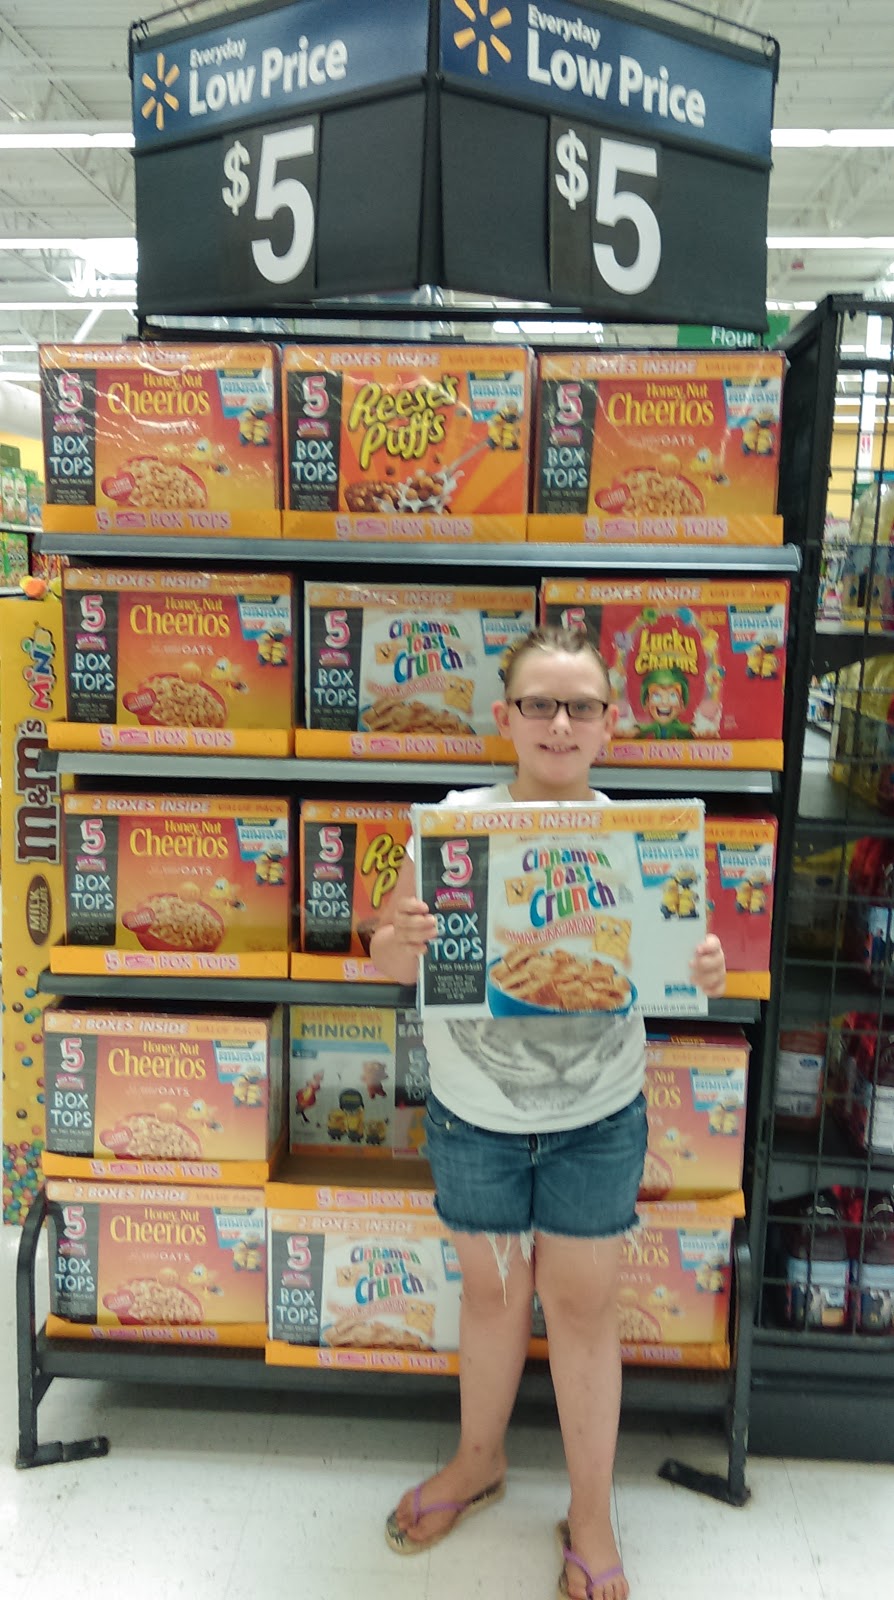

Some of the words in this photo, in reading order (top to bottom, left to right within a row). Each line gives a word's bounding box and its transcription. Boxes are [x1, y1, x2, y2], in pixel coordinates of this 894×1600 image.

[528, 3, 600, 50] Everyday
[190, 38, 247, 69] Everyday
[189, 65, 256, 117] Low
[261, 35, 347, 99] Price
[527, 28, 612, 100] Low
[619, 54, 706, 128] Price
[330, 352, 382, 365] BOXES
[386, 352, 440, 367] INSIDE
[571, 360, 581, 373] 2
[586, 359, 638, 375] BOXES
[643, 360, 697, 375] INSIDE
[143, 373, 180, 389] Honey
[182, 373, 203, 388] Nut
[646, 383, 684, 398] Honey
[686, 383, 708, 397] Nut
[58, 373, 83, 413] 5
[108, 382, 210, 415] Cheerios
[302, 375, 329, 418] 5
[557, 384, 583, 426] 5
[608, 392, 714, 427] Cheerios
[53, 435, 90, 455] BOX
[295, 440, 334, 460] BOX
[50, 456, 93, 476] TOPS
[547, 447, 585, 467] BOX
[292, 462, 338, 482] TOPS
[543, 468, 588, 488] TOPS
[150, 512, 184, 529] BOX
[187, 512, 232, 529] TOPS
[391, 519, 426, 536] BOX
[429, 519, 473, 536] TOPS
[642, 519, 677, 537] BOX
[683, 518, 728, 537] TOPS
[106, 574, 155, 588] BOXES
[161, 575, 210, 589] INSIDE
[590, 585, 642, 600] BOXES
[647, 586, 701, 599] INSIDE
[80, 594, 106, 633] 5
[165, 597, 200, 612] Honey
[202, 597, 223, 612] Nut
[130, 604, 230, 637] Cheerios
[325, 610, 350, 649] 5
[390, 618, 460, 639] Cinnamon
[182, 645, 214, 655] OATS
[407, 634, 446, 652] Toast
[640, 628, 696, 656] Lucky
[75, 653, 111, 671] BOX
[394, 646, 463, 684] Crunch
[635, 652, 699, 675] Charms
[71, 672, 116, 691] TOPS
[318, 668, 354, 686] BOX
[314, 688, 357, 706] TOPS
[99, 726, 114, 748] 5
[153, 729, 187, 746] BOX
[192, 731, 235, 747] TOPS
[405, 737, 437, 753] BOX
[444, 738, 483, 754] TOPS
[688, 745, 733, 760] TOPS
[93, 800, 101, 810] 2
[107, 799, 155, 812] BOXES
[160, 800, 210, 813] INSIDE
[345, 807, 393, 819] BOXES
[164, 820, 200, 835] Honey
[202, 821, 221, 835] Nut
[454, 814, 466, 830] 2
[471, 812, 533, 830] BOXES
[539, 812, 602, 829] INSIDE
[80, 818, 106, 855] 5
[130, 828, 229, 859] Cheerios
[319, 826, 344, 863] 5
[441, 839, 474, 888] 5
[522, 848, 612, 873] Cinnamon
[180, 866, 213, 876] OATS
[544, 864, 595, 890] Toast
[75, 874, 111, 892] BOX
[312, 881, 348, 899] BOX
[29, 888, 40, 931] MILK
[71, 892, 114, 910] TOPS
[307, 899, 350, 918] TOPS
[529, 881, 616, 928] Crunch
[435, 912, 479, 937] BOX
[430, 937, 484, 962] TOPS
[104, 951, 120, 970] 5
[159, 954, 193, 969] BOX
[198, 955, 240, 970] TOPS
[72, 1019, 81, 1029] 2
[85, 1018, 134, 1031] BOXES
[139, 1021, 188, 1034] INSIDE
[301, 1024, 382, 1039] MINION!
[60, 1037, 85, 1073] 5
[143, 1040, 177, 1055] Honey
[180, 1042, 199, 1055] Nut
[108, 1048, 206, 1080] Cheerios
[54, 1091, 89, 1109] BOX
[158, 1086, 191, 1097] OATS
[50, 1109, 92, 1128] TOPS
[142, 1164, 177, 1176] BOX
[181, 1164, 221, 1178] TOPS
[75, 1187, 83, 1197] 2
[88, 1186, 136, 1199] BOXES
[140, 1188, 188, 1201] INSIDE
[63, 1205, 87, 1240] 5
[144, 1208, 178, 1223] Honey
[180, 1209, 200, 1222] Nut
[311, 1216, 361, 1230] BOXES
[366, 1219, 415, 1233] INSIDE
[110, 1215, 207, 1246] Cheerios
[159, 1252, 191, 1262] OATS
[286, 1235, 312, 1271] 5
[351, 1247, 421, 1265] Cinnamon
[58, 1257, 91, 1274] BOX
[368, 1259, 407, 1277] Toast
[55, 1274, 95, 1292] TOPS
[355, 1272, 424, 1306] Crunch
[280, 1288, 315, 1305] BOX
[276, 1305, 319, 1324] TOPS
[408, 1353, 448, 1368] TOPS
